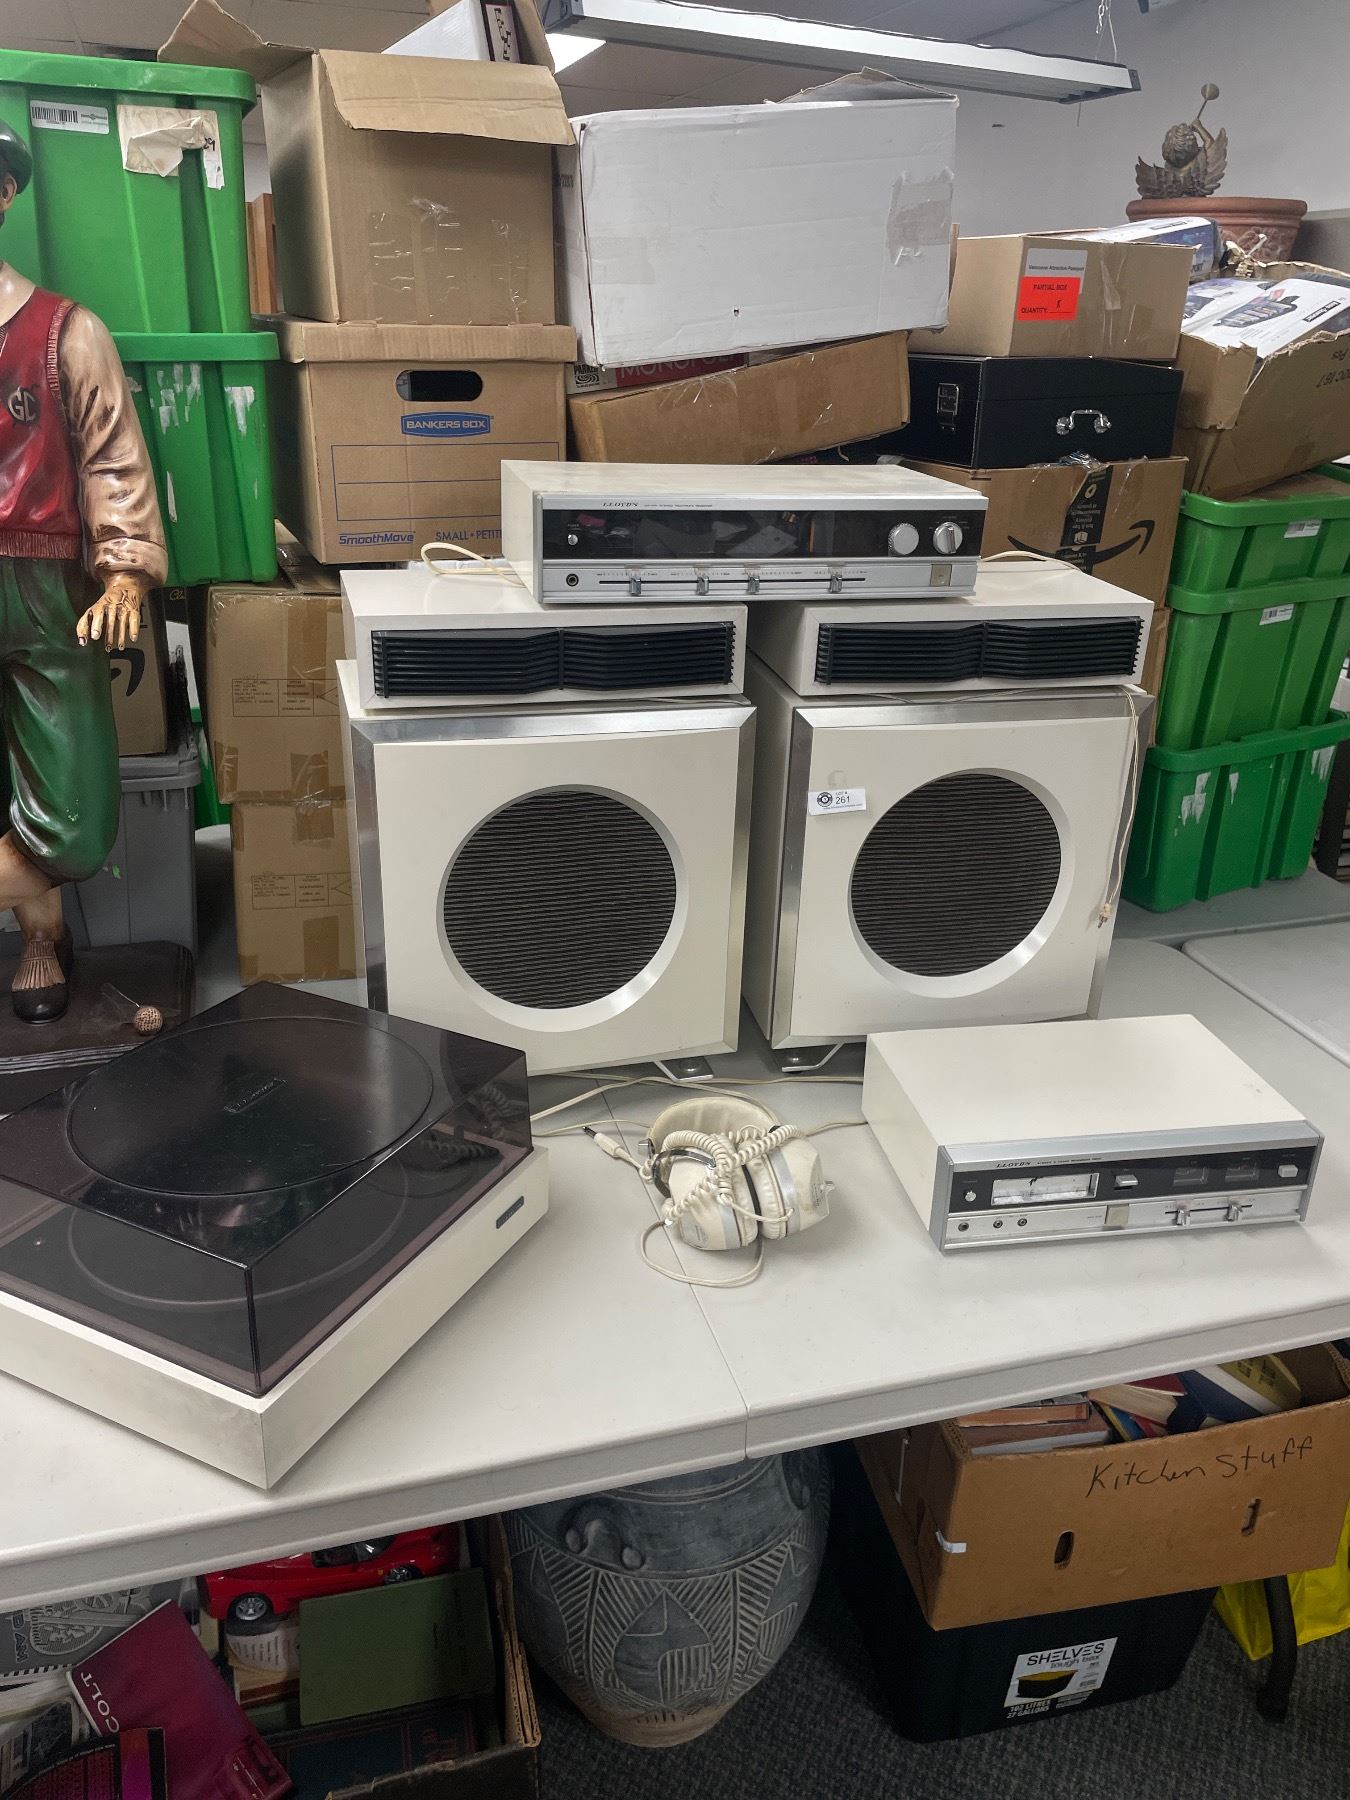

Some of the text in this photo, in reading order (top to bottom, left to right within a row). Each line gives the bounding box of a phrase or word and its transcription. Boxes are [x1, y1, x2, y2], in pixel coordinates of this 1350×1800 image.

[406, 420, 487, 429] BANKERS BOX
[339, 533, 414, 545] SmoothMove
[435, 529, 502, 541] SMALL PETIT
[835, 795, 850, 804] 261
[1086, 1436, 1313, 1498] Kitchen Stuff
[1027, 1642, 1105, 1666] SHELVES
[80, 1671, 120, 1734] COLT
